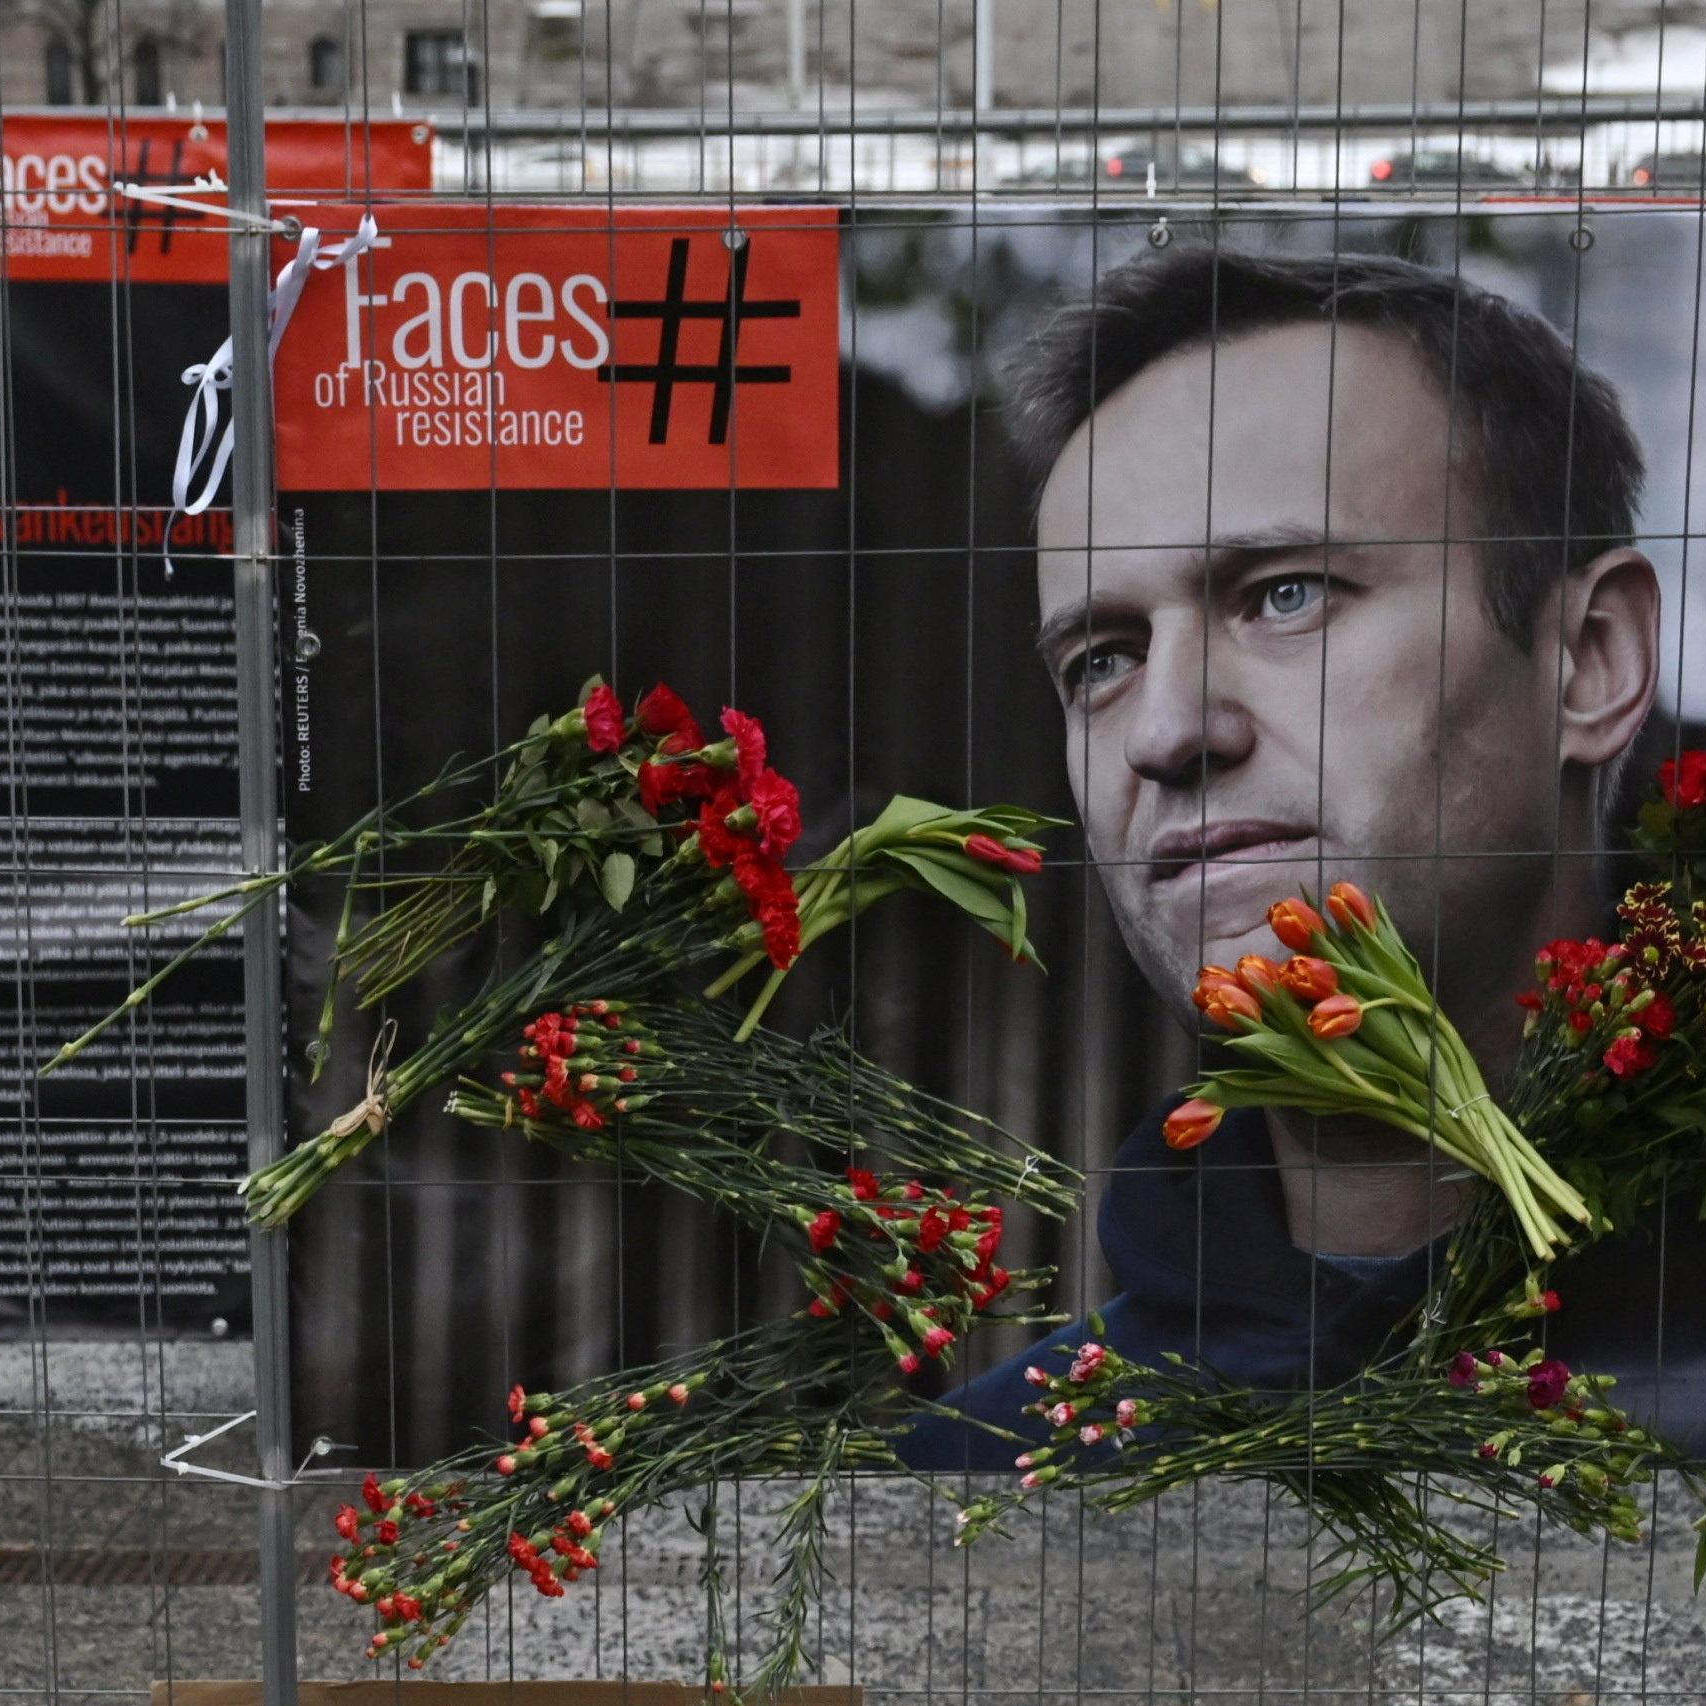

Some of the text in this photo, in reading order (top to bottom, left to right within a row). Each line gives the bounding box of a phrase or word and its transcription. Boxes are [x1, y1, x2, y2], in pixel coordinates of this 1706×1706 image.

[343, 237, 611, 370] Faces
[314, 361, 505, 409] of Russian
[396, 407, 584, 447] resistance
[292, 606, 308, 664] Eenia
[295, 675, 310, 742] REUTERS
[298, 746, 311, 792] Photo:
